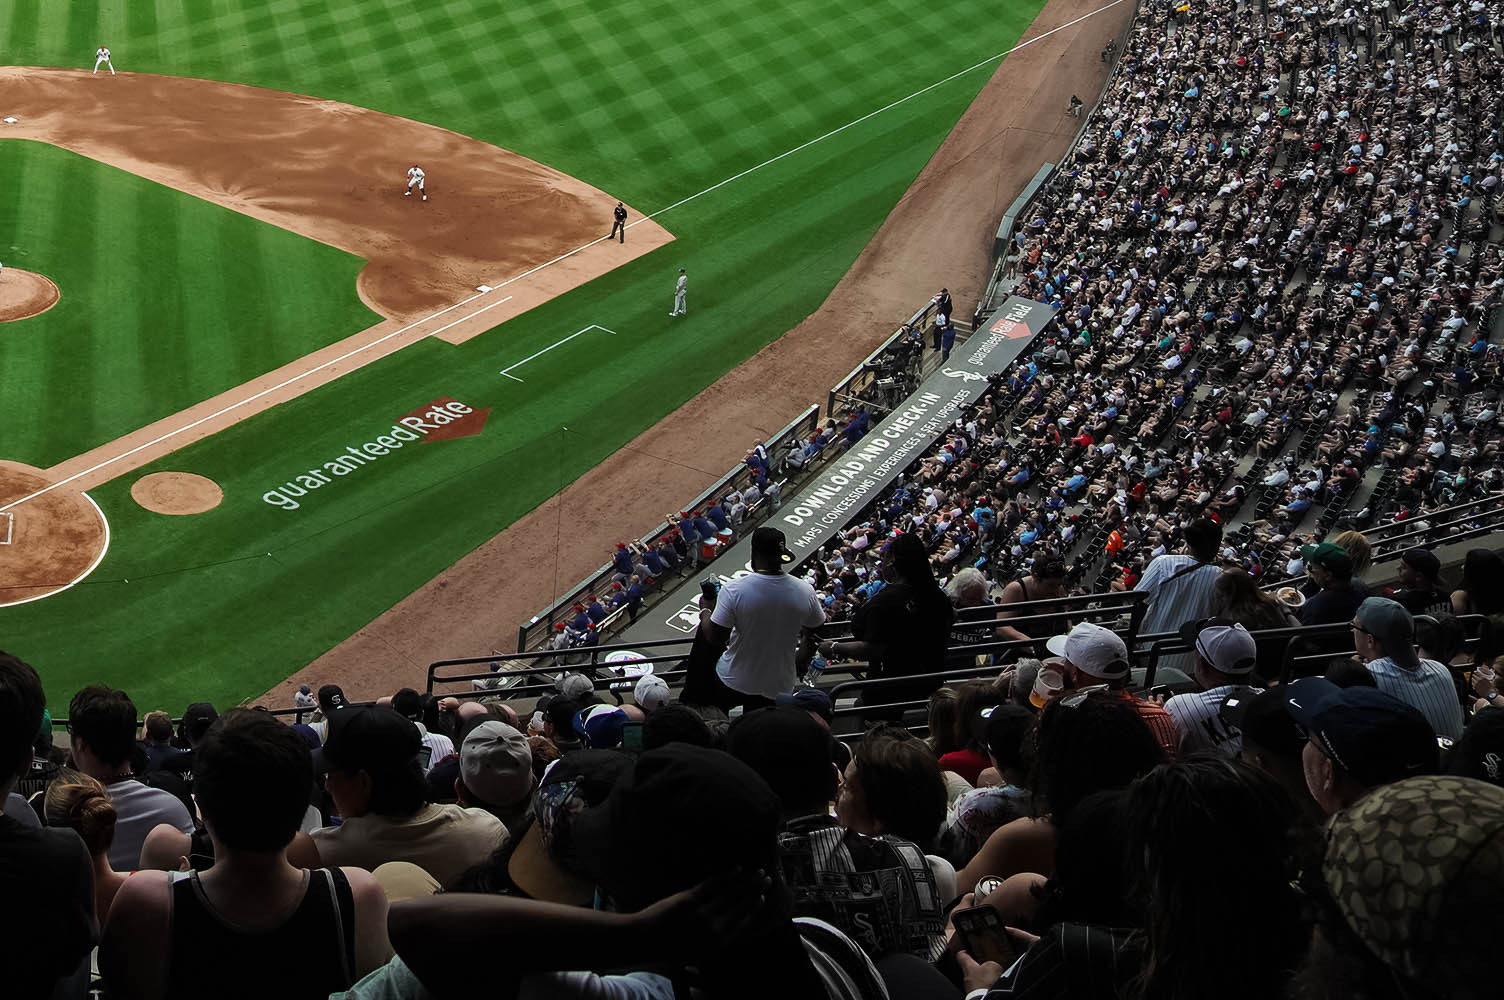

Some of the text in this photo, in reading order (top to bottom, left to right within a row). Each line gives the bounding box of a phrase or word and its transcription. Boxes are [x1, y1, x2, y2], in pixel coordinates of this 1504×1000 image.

[968, 331, 1005, 366] guaranteed
[1005, 303, 1033, 323] Field
[262, 400, 473, 510] guaranteed Rate
[783, 392, 942, 528] DOWNLOAD AND CHECK-IN
[794, 388, 971, 549] MAPS CONCESSIONS EXPERIENCES SEAT UPGRADES
